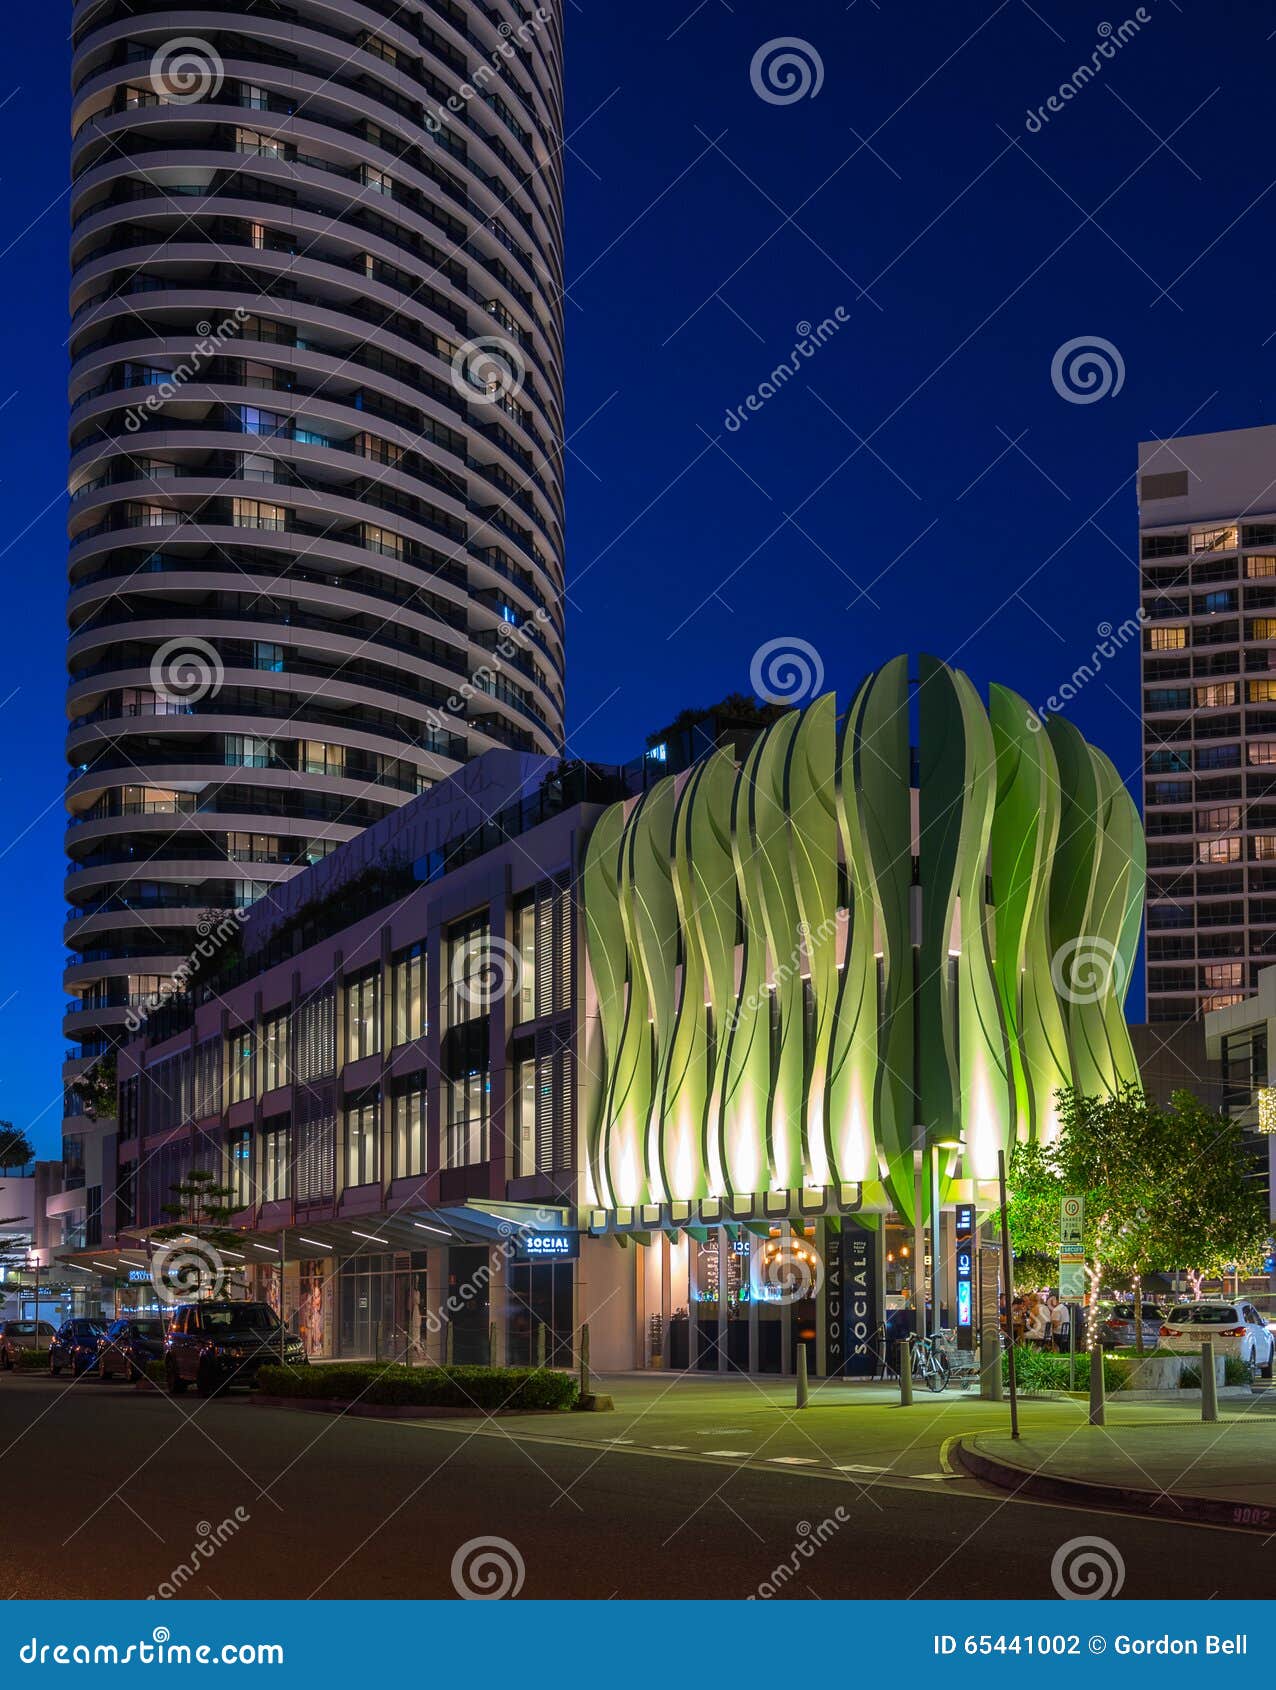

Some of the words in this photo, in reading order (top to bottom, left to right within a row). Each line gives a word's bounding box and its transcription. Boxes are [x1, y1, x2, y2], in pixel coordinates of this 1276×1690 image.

[527, 1238, 569, 1248] SOCIAL
[829, 1257, 840, 1354] SOCIAL
[854, 1257, 867, 1355] SOCIAL
